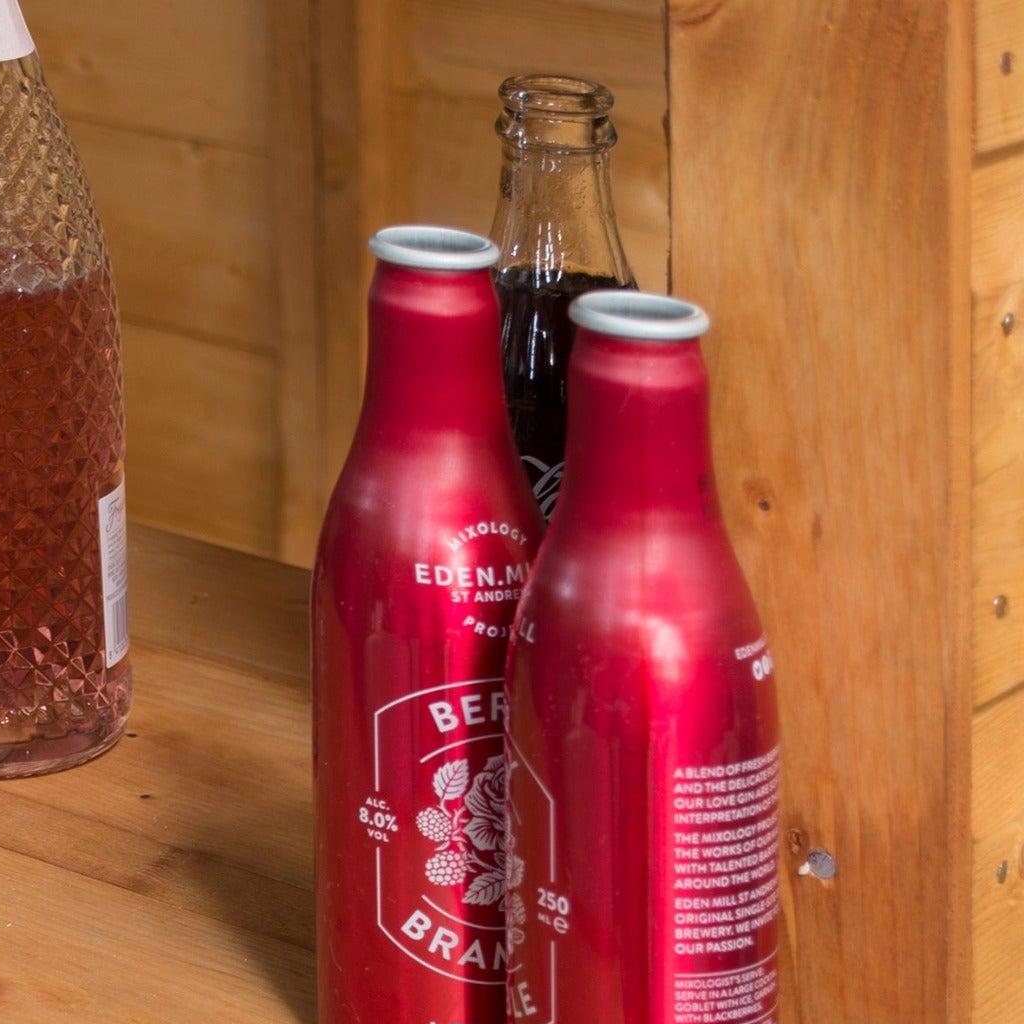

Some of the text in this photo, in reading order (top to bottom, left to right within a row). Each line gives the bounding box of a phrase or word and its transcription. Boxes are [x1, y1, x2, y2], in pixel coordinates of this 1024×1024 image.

[448, 521, 527, 552] MIXOLOGY
[450, 590, 470, 603] ST
[685, 765, 724, 778] BLEND
[725, 762, 741, 776] OF
[673, 783, 702, 793] AND
[705, 780, 726, 793] THE
[366, 797, 390, 811] ALC.
[673, 797, 703, 809] OUR
[705, 794, 735, 809] LOVE
[737, 788, 754, 805] GIN
[359, 807, 398, 832] 8.0%
[367, 828, 389, 842] VOL
[673, 833, 698, 844] THE
[701, 822, 756, 844] MIXOLOGY
[673, 848, 698, 859] THE
[702, 842, 741, 859] WORKS
[673, 852, 758, 874] WITH TALENTED
[673, 875, 728, 889] AROUND
[731, 870, 749, 886] THE
[537, 887, 569, 916] 250
[674, 898, 708, 909] EDEN
[711, 894, 736, 908] MILL
[674, 910, 733, 924] ORIGINAL
[735, 920, 750, 935] WE
[674, 943, 703, 954] OUR
